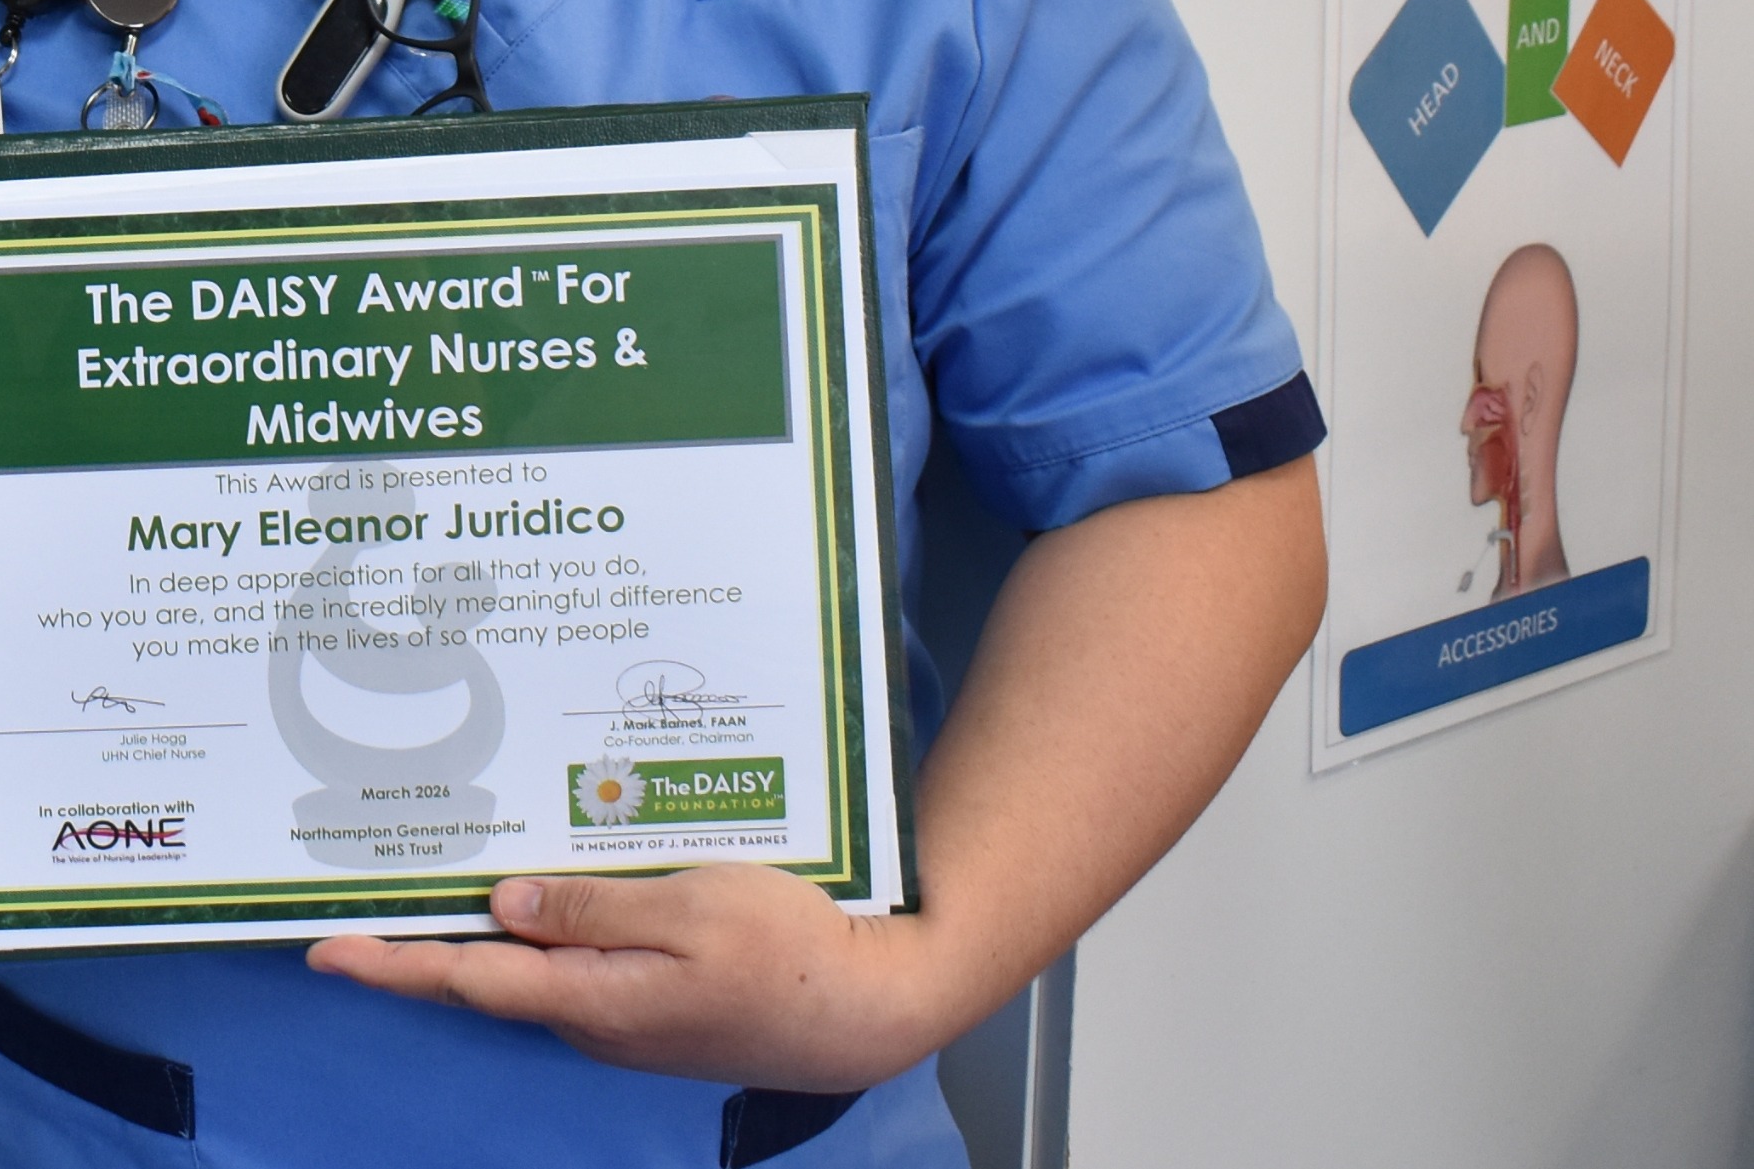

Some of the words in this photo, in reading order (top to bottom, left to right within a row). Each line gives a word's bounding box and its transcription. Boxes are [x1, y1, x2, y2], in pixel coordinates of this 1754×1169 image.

[1515, 17, 1560, 50] AND
[1593, 39, 1639, 99] NECK
[1407, 61, 1460, 137] HEAD
[85, 283, 173, 325] The
[191, 275, 338, 321] DAISY
[556, 263, 631, 305] For
[77, 336, 414, 389] Extraordinary
[430, 331, 598, 375] Nurses
[614, 327, 649, 367] &
[246, 398, 484, 446] Midwives
[215, 472, 258, 495] This
[266, 469, 351, 493] Award
[358, 468, 374, 490] is
[382, 462, 513, 493] presented
[522, 462, 548, 483] to
[127, 515, 241, 557] Mary
[259, 509, 429, 547] Eleanor
[444, 498, 626, 540] Juridico
[129, 572, 152, 596] In
[158, 571, 230, 598] deep
[235, 563, 405, 596] appreciation
[412, 561, 446, 583] for
[453, 560, 482, 582] all
[489, 558, 542, 580] that
[548, 559, 598, 583] you
[605, 554, 648, 578] do,
[36, 607, 93, 630] who
[99, 610, 147, 633] you
[155, 609, 205, 628] are,
[213, 602, 265, 624] and
[273, 599, 315, 622] the
[321, 591, 448, 620] incredibly
[456, 588, 601, 615] meaningful
[609, 585, 742, 608] difference
[131, 640, 179, 665] you
[188, 632, 260, 656] make
[267, 631, 290, 654] in
[296, 629, 338, 652] the
[345, 627, 399, 651] lives
[407, 625, 435, 647] of
[440, 628, 467, 646] so
[475, 623, 548, 648] many
[557, 617, 650, 646] people
[1437, 606, 1559, 669] ACCESSORIES
[119, 733, 148, 747] Julie
[151, 733, 187, 747] Hogg
[603, 734, 685, 749] Co-Founder,
[688, 731, 754, 745] Chairman
[609, 720, 620, 732] J.
[624, 718, 656, 731] Mark
[710, 715, 747, 727] FAAN
[101, 750, 129, 762] UHN
[132, 748, 168, 761] Chief
[170, 747, 206, 760] Nurse
[360, 786, 411, 801] March
[415, 784, 451, 799] 2026
[650, 777, 691, 797] The
[694, 770, 775, 795] DAISY
[38, 805, 53, 819] In
[57, 802, 160, 817] collaboration
[164, 800, 195, 814] with
[51, 817, 187, 852] AONE
[290, 825, 392, 843] Northampton
[396, 822, 460, 837] General
[463, 819, 526, 837] Hospital
[571, 842, 585, 853] IN
[587, 839, 643, 852] MEMORY
[647, 839, 665, 850] OF
[668, 837, 679, 849] J.
[683, 836, 735, 848] PATRICK
[739, 834, 789, 846] BARNES
[52, 855, 66, 864] The
[68, 854, 91, 864] Voice
[92, 854, 101, 863] of
[102, 853, 135, 864] Nursing
[374, 842, 405, 857] NHS
[410, 841, 445, 856] Trust
